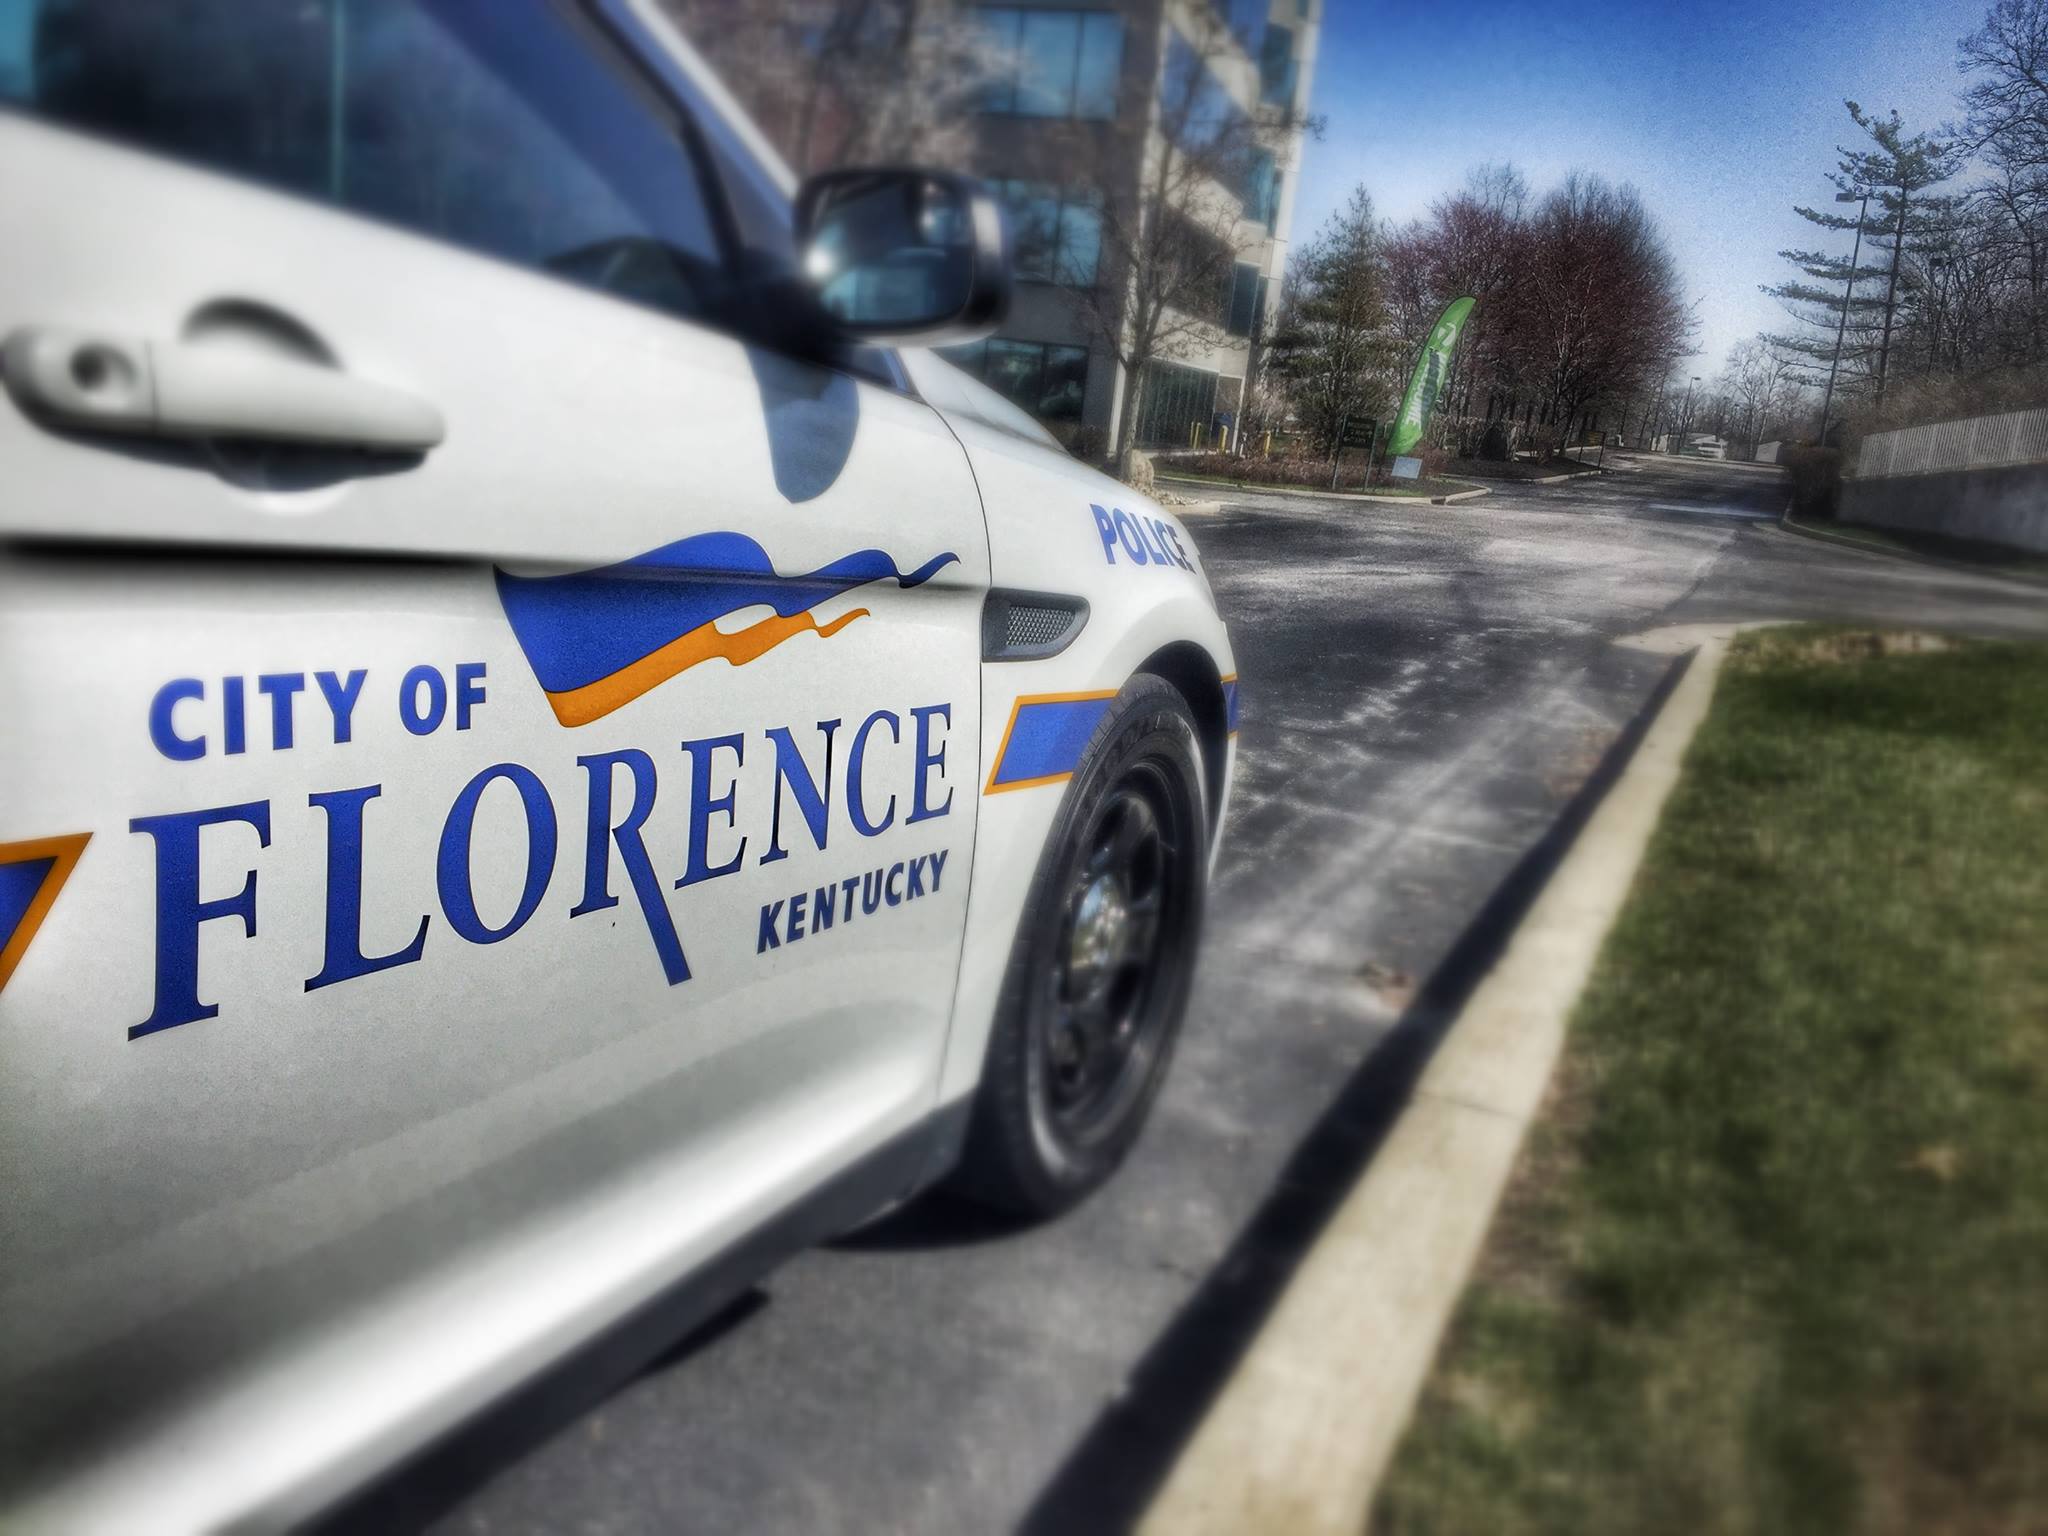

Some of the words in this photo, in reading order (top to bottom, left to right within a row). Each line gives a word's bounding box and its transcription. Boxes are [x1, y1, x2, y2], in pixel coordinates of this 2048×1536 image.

[1089, 503, 1197, 575] POLICE
[148, 668, 369, 762] CITY
[399, 662, 488, 736] OF
[127, 702, 954, 1042] FLORENCE
[756, 849, 950, 955] KENTUCKY
